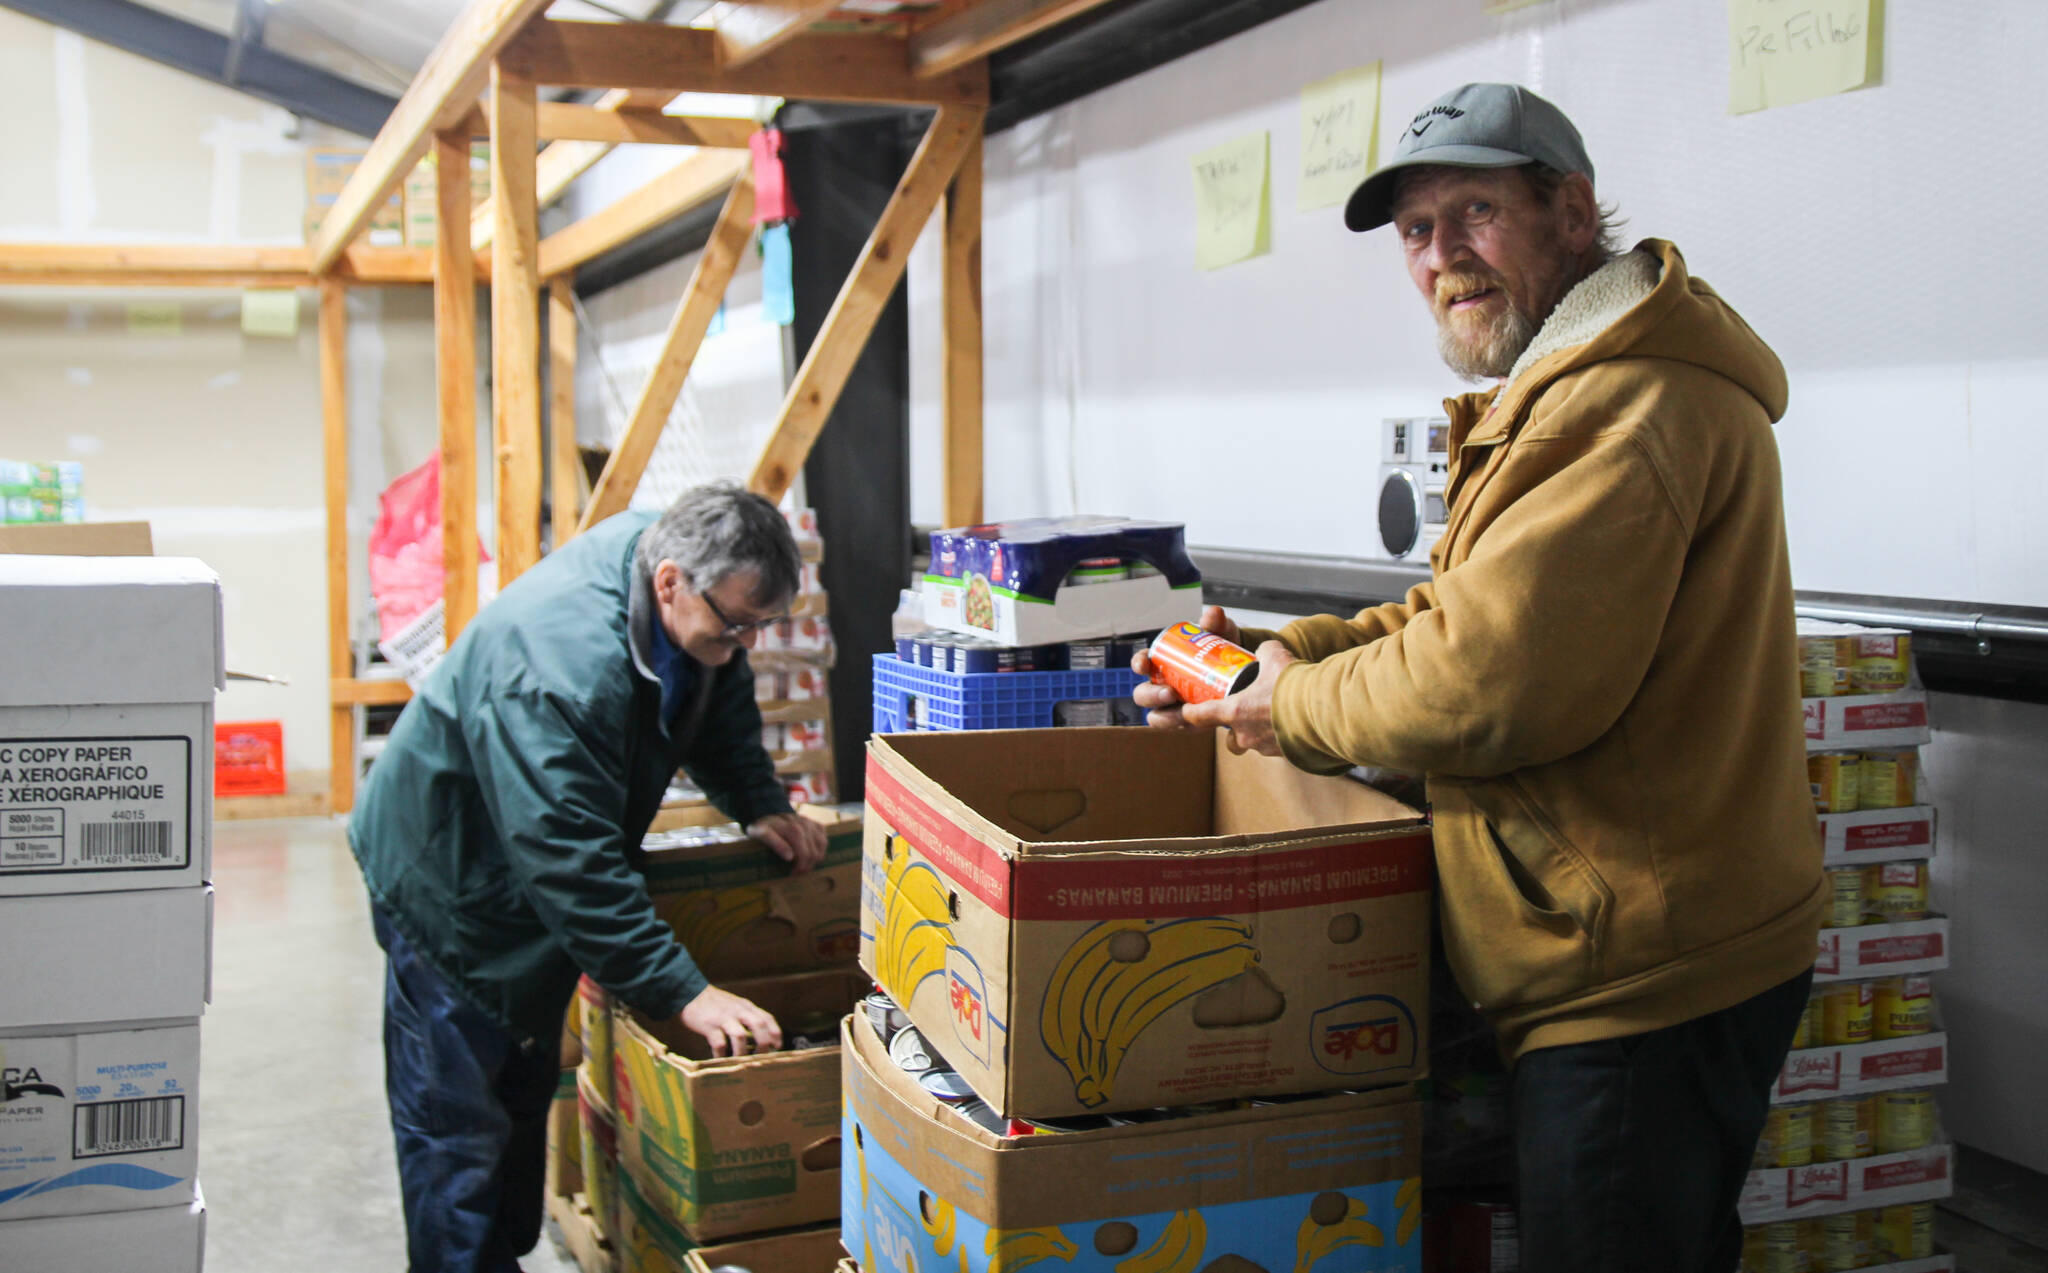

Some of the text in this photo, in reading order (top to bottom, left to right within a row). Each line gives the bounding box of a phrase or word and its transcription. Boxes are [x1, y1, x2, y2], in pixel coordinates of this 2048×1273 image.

[18, 748, 69, 764] COPY
[75, 747, 132, 762] PAPER
[19, 762, 148, 783] XEROGRÁFICO
[8, 783, 164, 803] XÉROGRAPHIQUE
[9, 814, 31, 824] 5000
[112, 810, 145, 820] 44015
[15, 842, 26, 851] 10
[1057, 863, 1399, 906] PREMIUM BANANAS PREMIUM BANANAS
[950, 978, 982, 1043] Dole
[1324, 1025, 1400, 1062] Dole
[97, 1061, 167, 1074] MULTI-PURPOSE
[76, 1086, 101, 1095] 5000
[120, 1083, 132, 1092] 20
